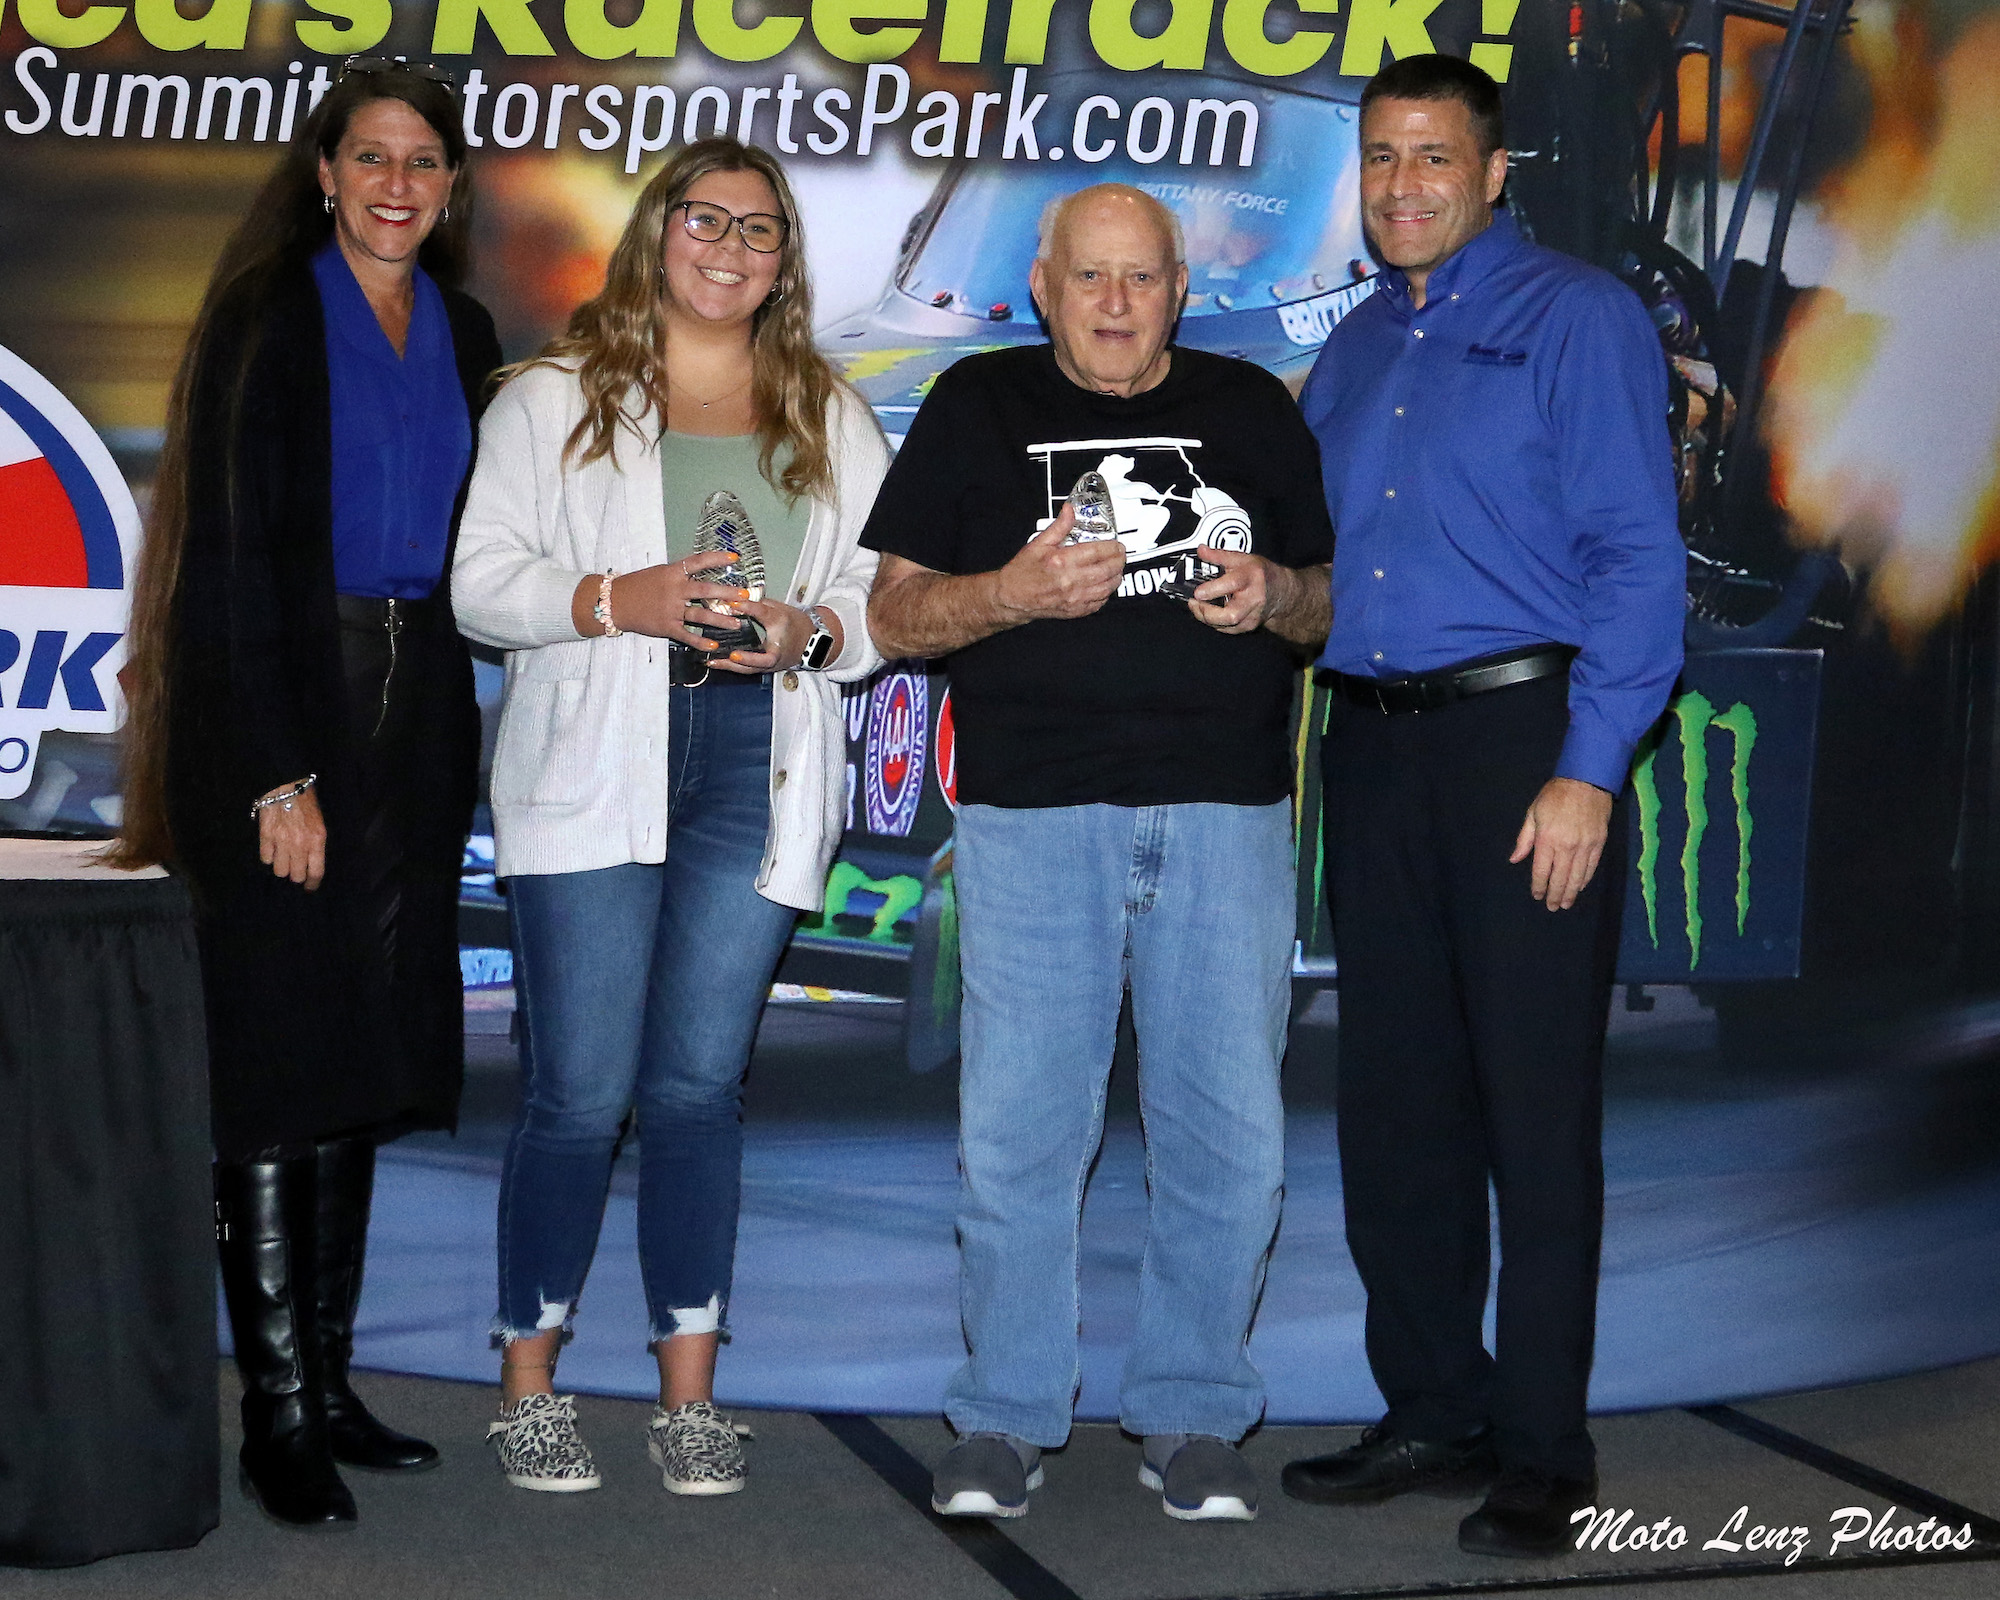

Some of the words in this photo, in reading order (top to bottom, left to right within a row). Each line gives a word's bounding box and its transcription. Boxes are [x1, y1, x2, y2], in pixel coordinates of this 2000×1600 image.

[4, 46, 1259, 173] SummittorsportsPark.com
[1223, 190, 1290, 215] FORCE
[0, 628, 125, 712] K
